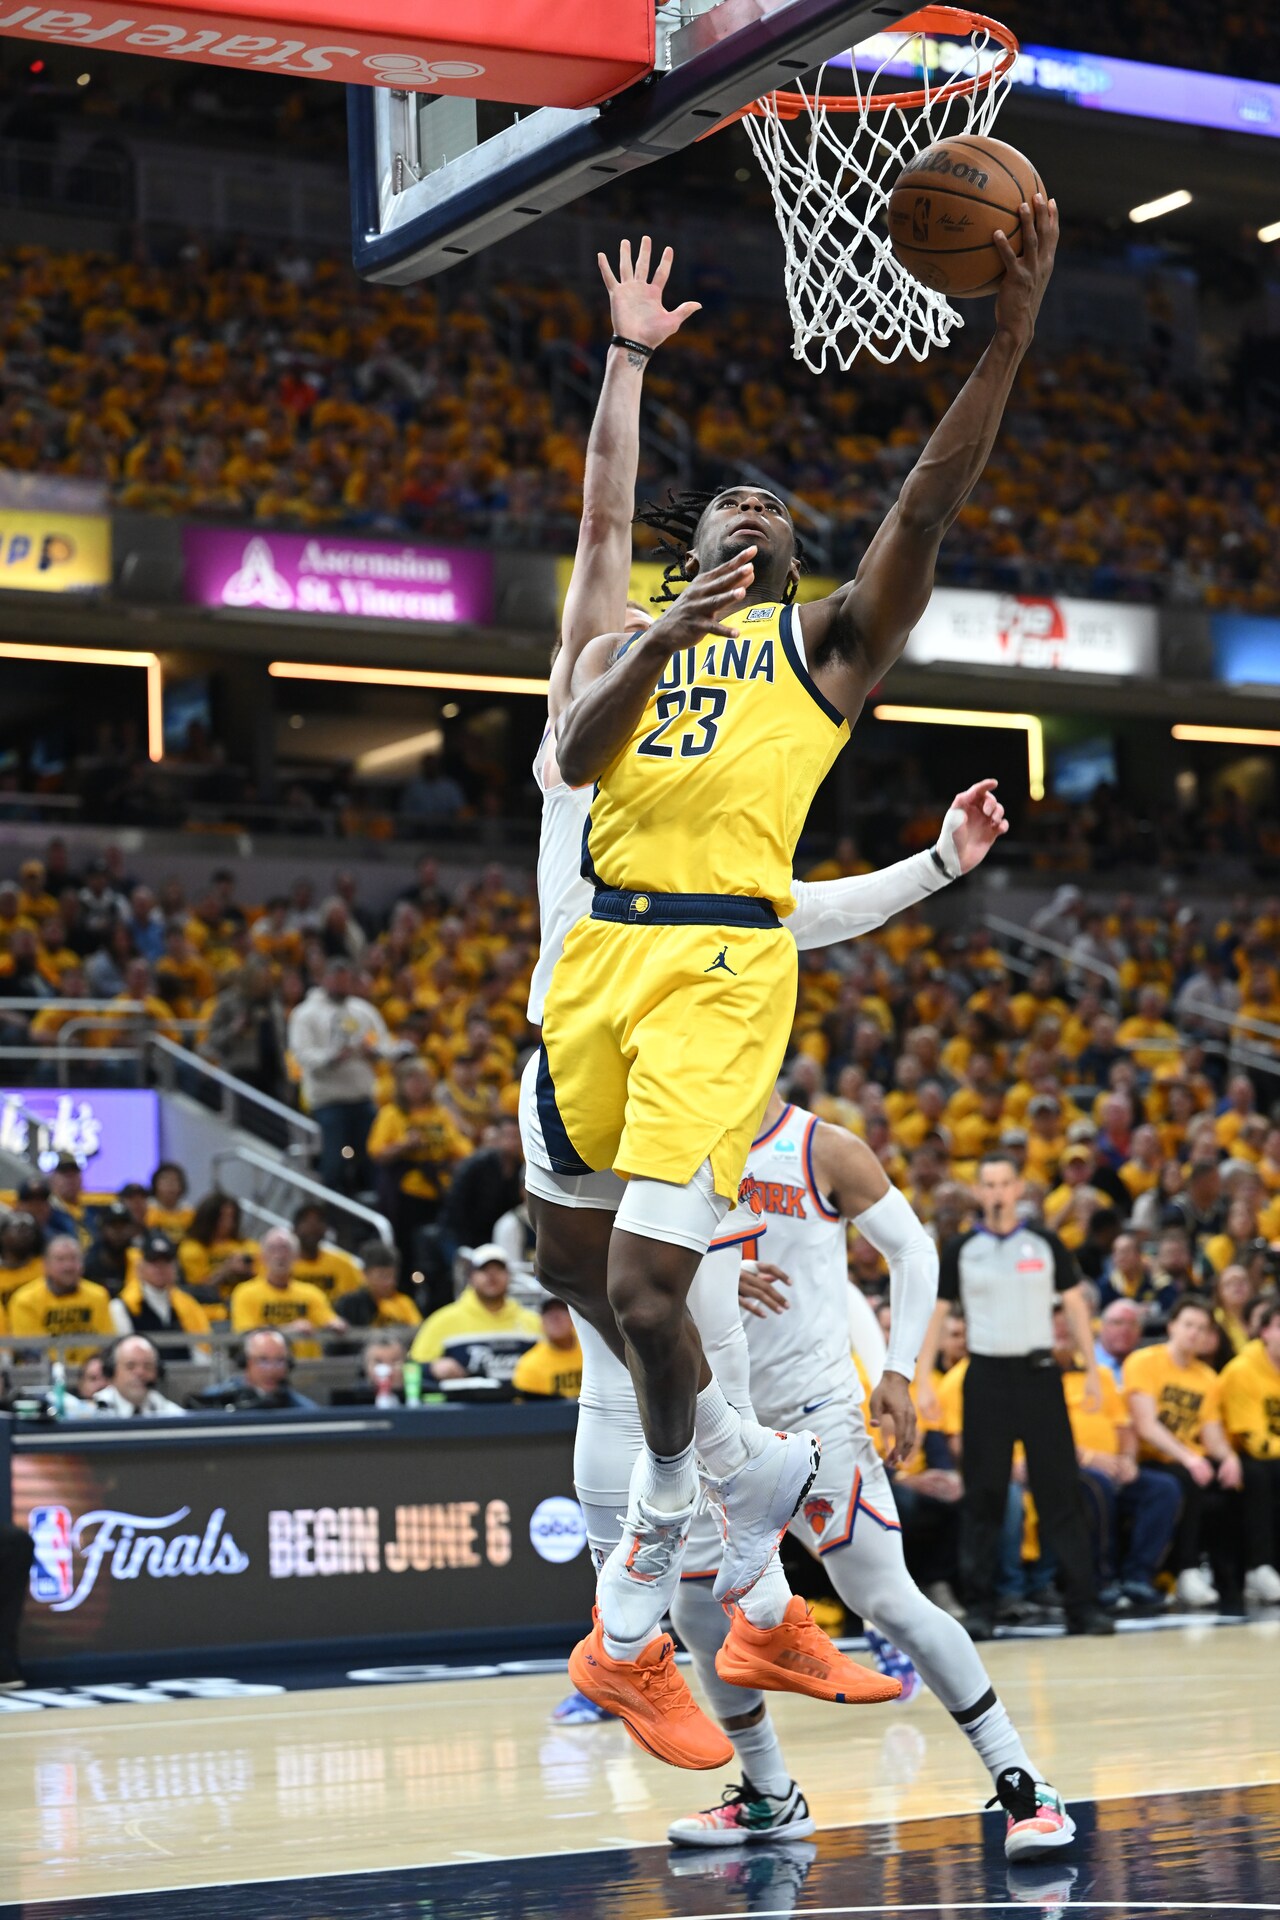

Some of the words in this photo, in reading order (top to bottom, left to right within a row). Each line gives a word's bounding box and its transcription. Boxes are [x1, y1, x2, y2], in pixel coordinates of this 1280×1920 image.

[0, 6, 136, 44] Far
[126, 24, 360, 72] State
[298, 539, 452, 584] Ascension
[338, 578, 456, 622] Vincent
[653, 639, 774, 693] DIANA
[636, 686, 727, 758] 23
[754, 1181, 807, 1219] ORK
[50, 1506, 249, 1611] Finals
[268, 1507, 380, 1578] BEGIN
[385, 1502, 481, 1572] JUNE
[485, 1499, 511, 1567] 6
